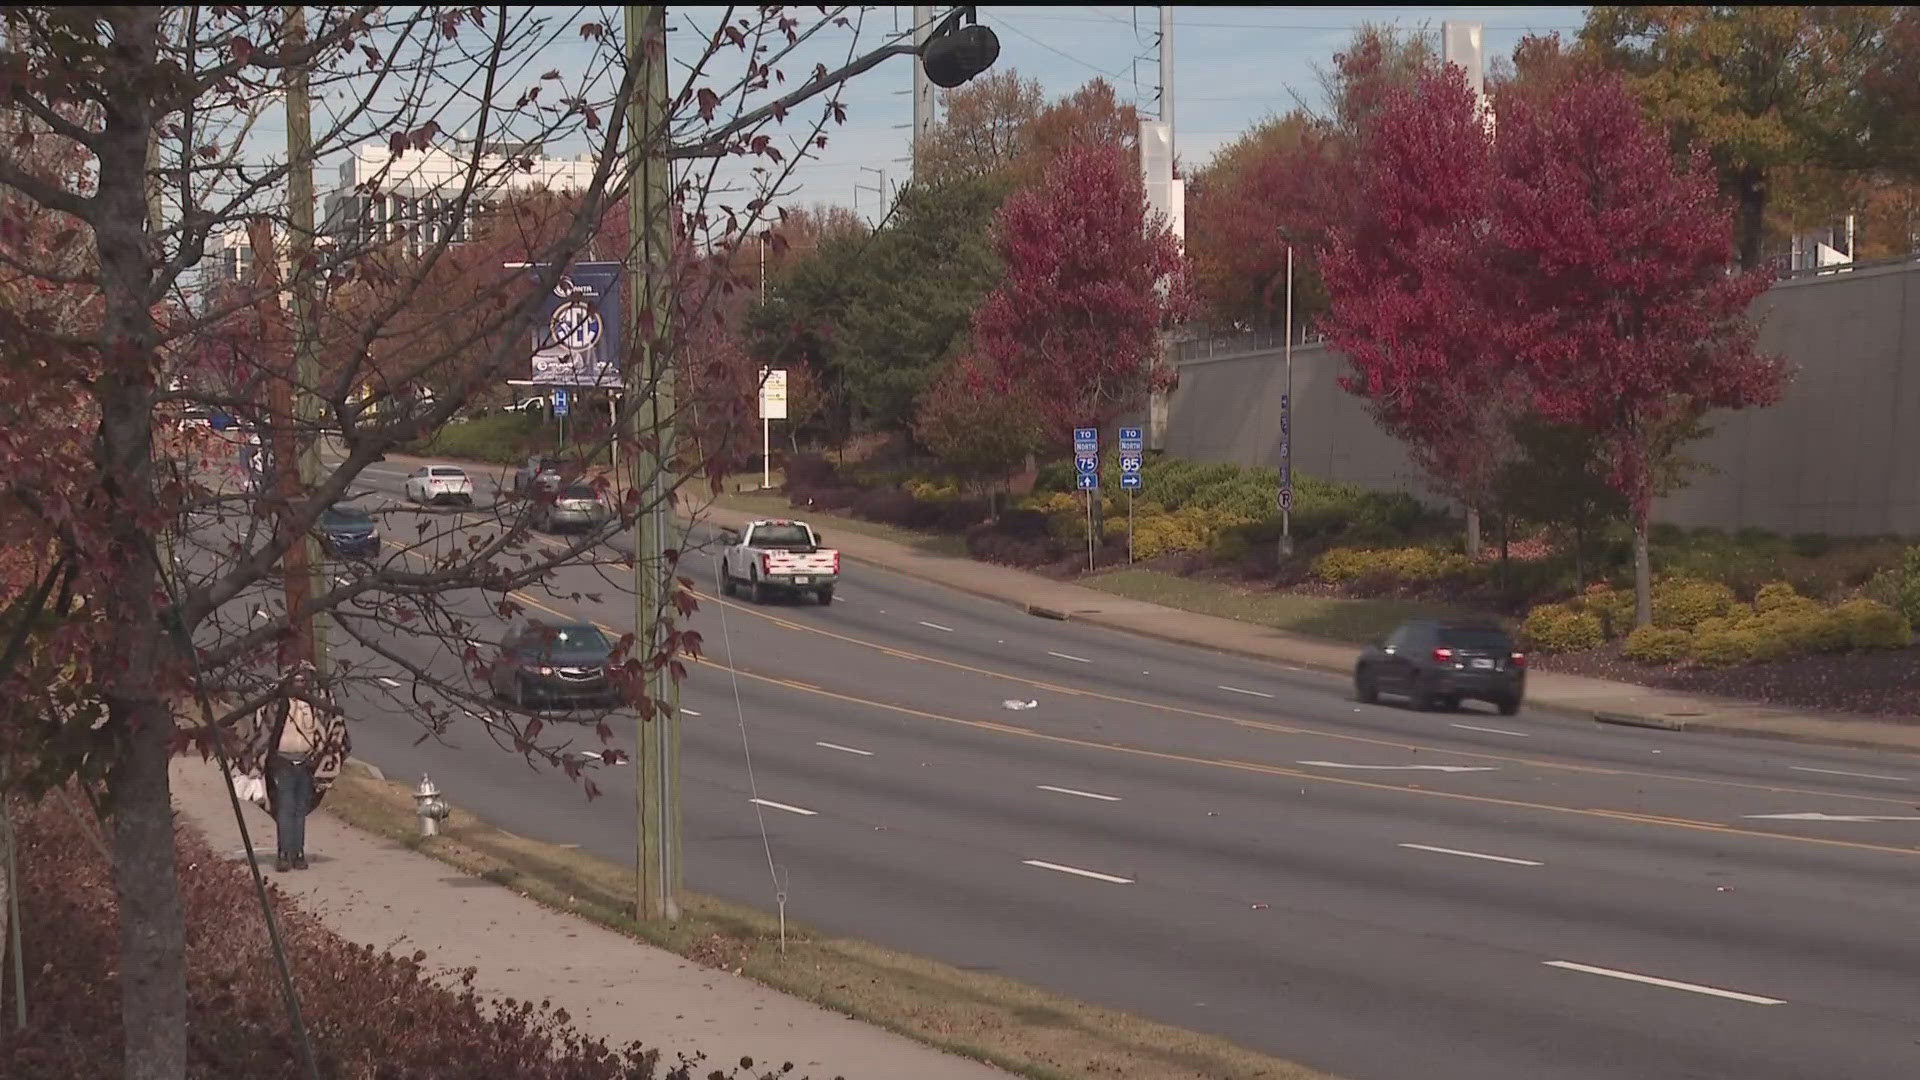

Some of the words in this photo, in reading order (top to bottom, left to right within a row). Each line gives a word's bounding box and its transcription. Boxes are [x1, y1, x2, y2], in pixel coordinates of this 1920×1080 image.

[555, 392, 567, 406] H
[1077, 443, 1096, 451] NORTH
[1121, 442, 1141, 451] NORTH
[1079, 458, 1095, 469] 75
[1123, 459, 1139, 471] 85
